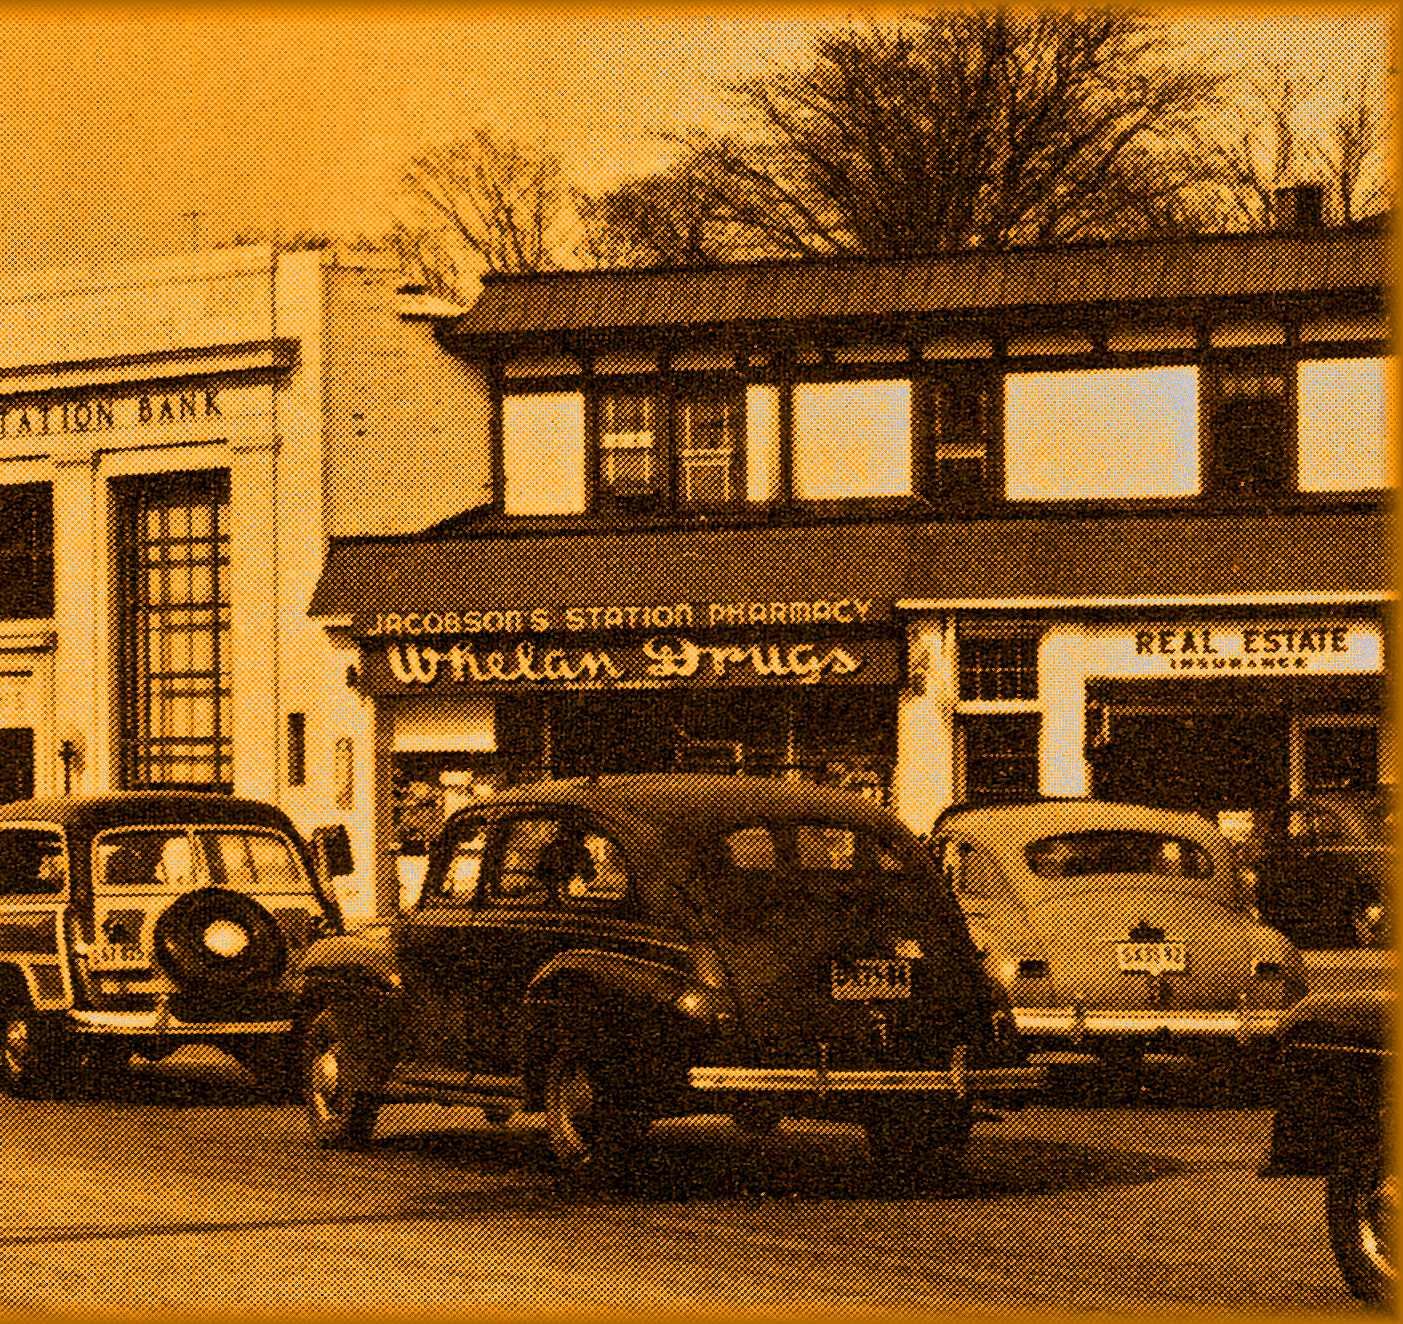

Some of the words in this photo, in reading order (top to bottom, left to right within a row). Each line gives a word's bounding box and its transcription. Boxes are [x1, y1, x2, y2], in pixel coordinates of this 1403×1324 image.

[138, 389, 223, 424] BANK
[565, 603, 694, 632] STATION
[708, 598, 872, 627] PHARMACY
[1135, 630, 1218, 656] REAL
[1244, 626, 1348, 654] ESTATE
[386, 640, 625, 684] Whelan
[642, 636, 864, 685] Drugs
[1170, 656, 1308, 670] INSURANCE
